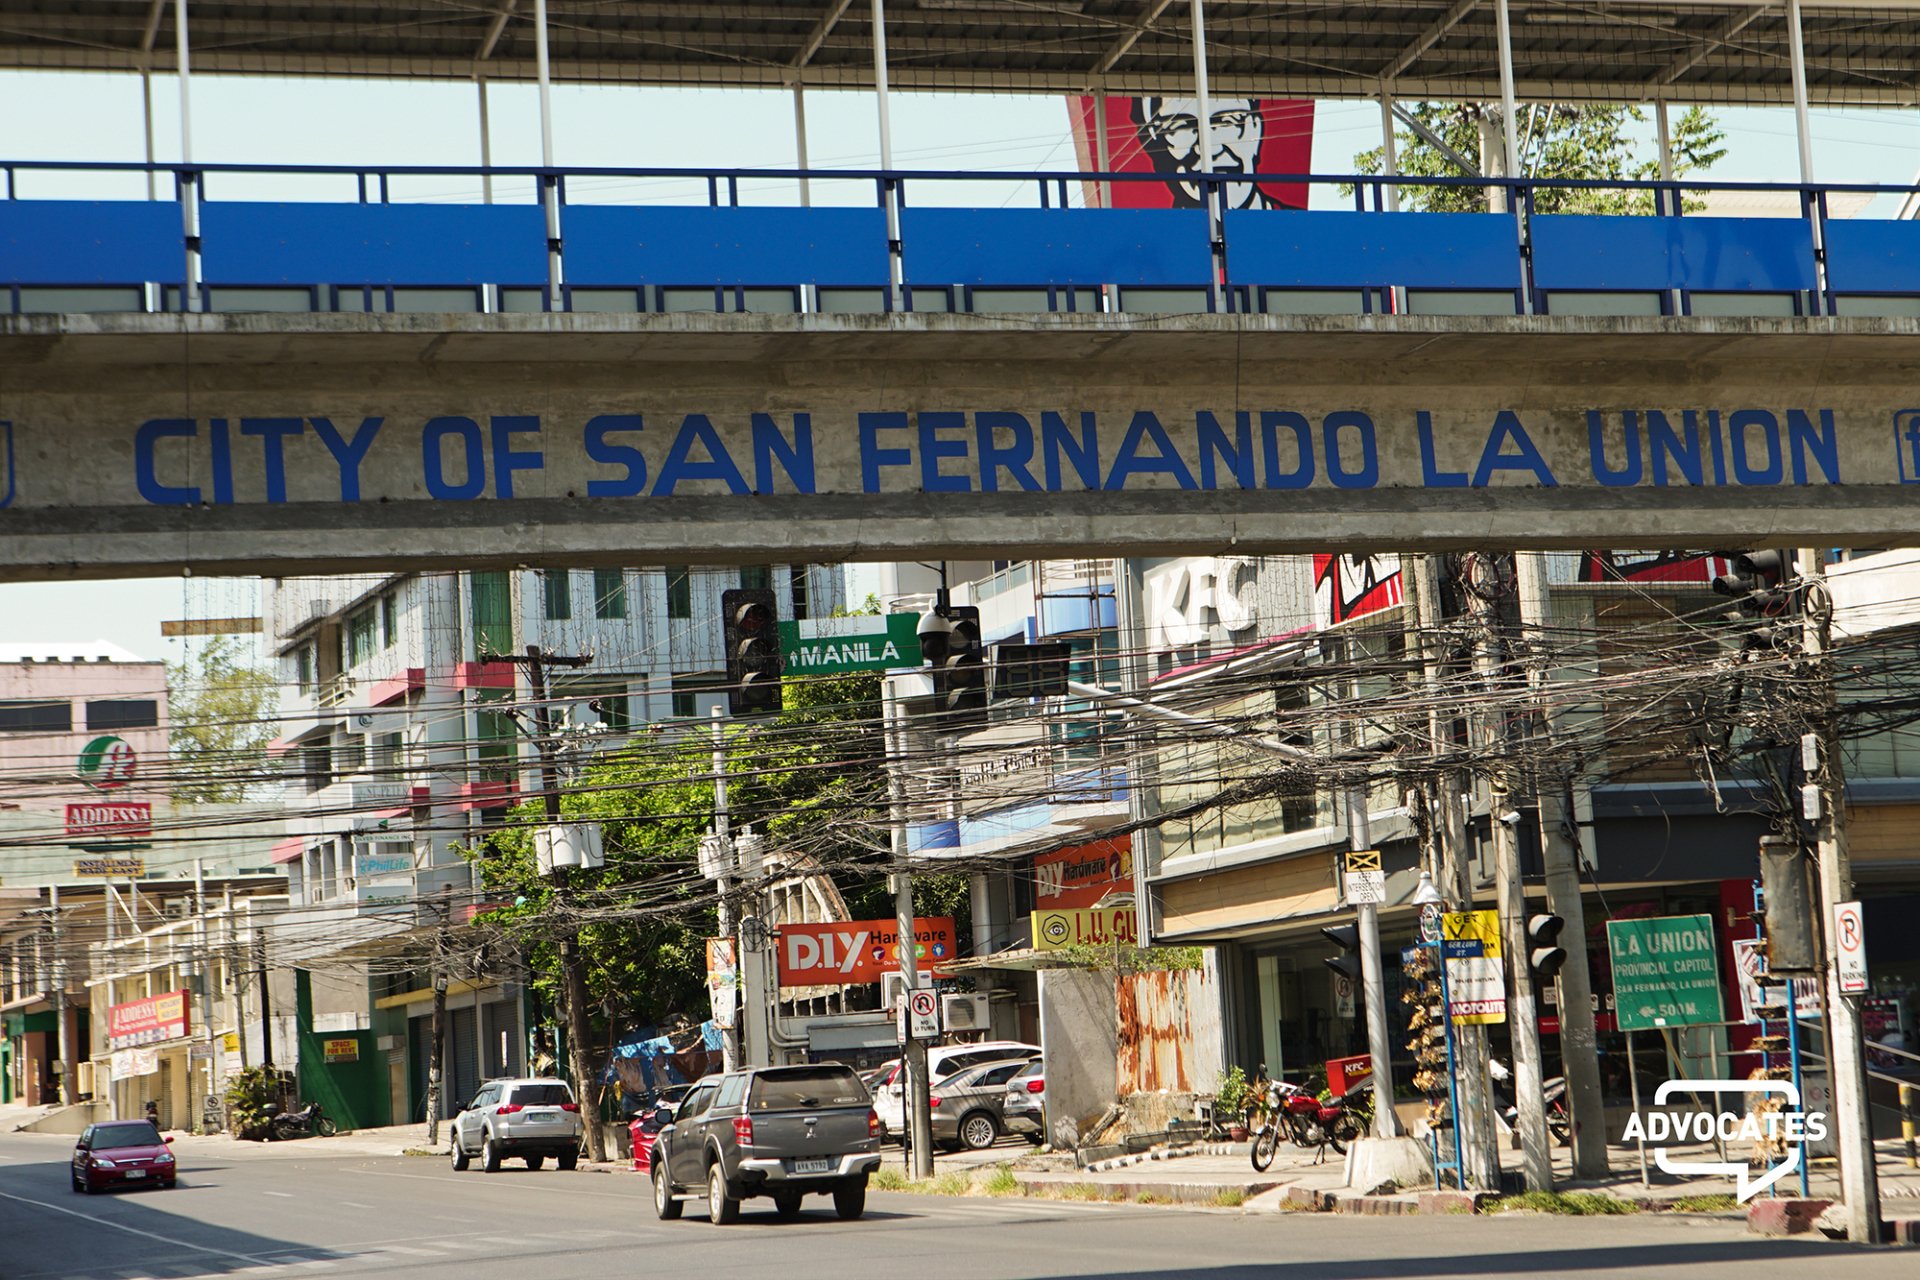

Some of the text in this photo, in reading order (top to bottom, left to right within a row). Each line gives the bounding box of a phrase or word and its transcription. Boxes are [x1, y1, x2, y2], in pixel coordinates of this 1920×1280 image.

[135, 408, 1842, 505] CITY OF SAN FERNANDO LA UNION
[1149, 560, 1258, 648] KFC
[801, 641, 900, 667] MANILA
[69, 807, 150, 826] ADDESSA
[111, 867, 141, 875] EASY
[1064, 856, 1106, 881] Hardware
[870, 930, 947, 945] Harware
[1613, 929, 1711, 957] LA UNION
[1615, 958, 1713, 977] PROVINCIAL CAPITOL
[1617, 985, 1633, 994] SAN
[1680, 980, 1691, 990] LA
[1691, 978, 1716, 989] UNION
[1452, 1001, 1506, 1016] MOTOLITE
[1345, 1062, 1365, 1073] KFC
